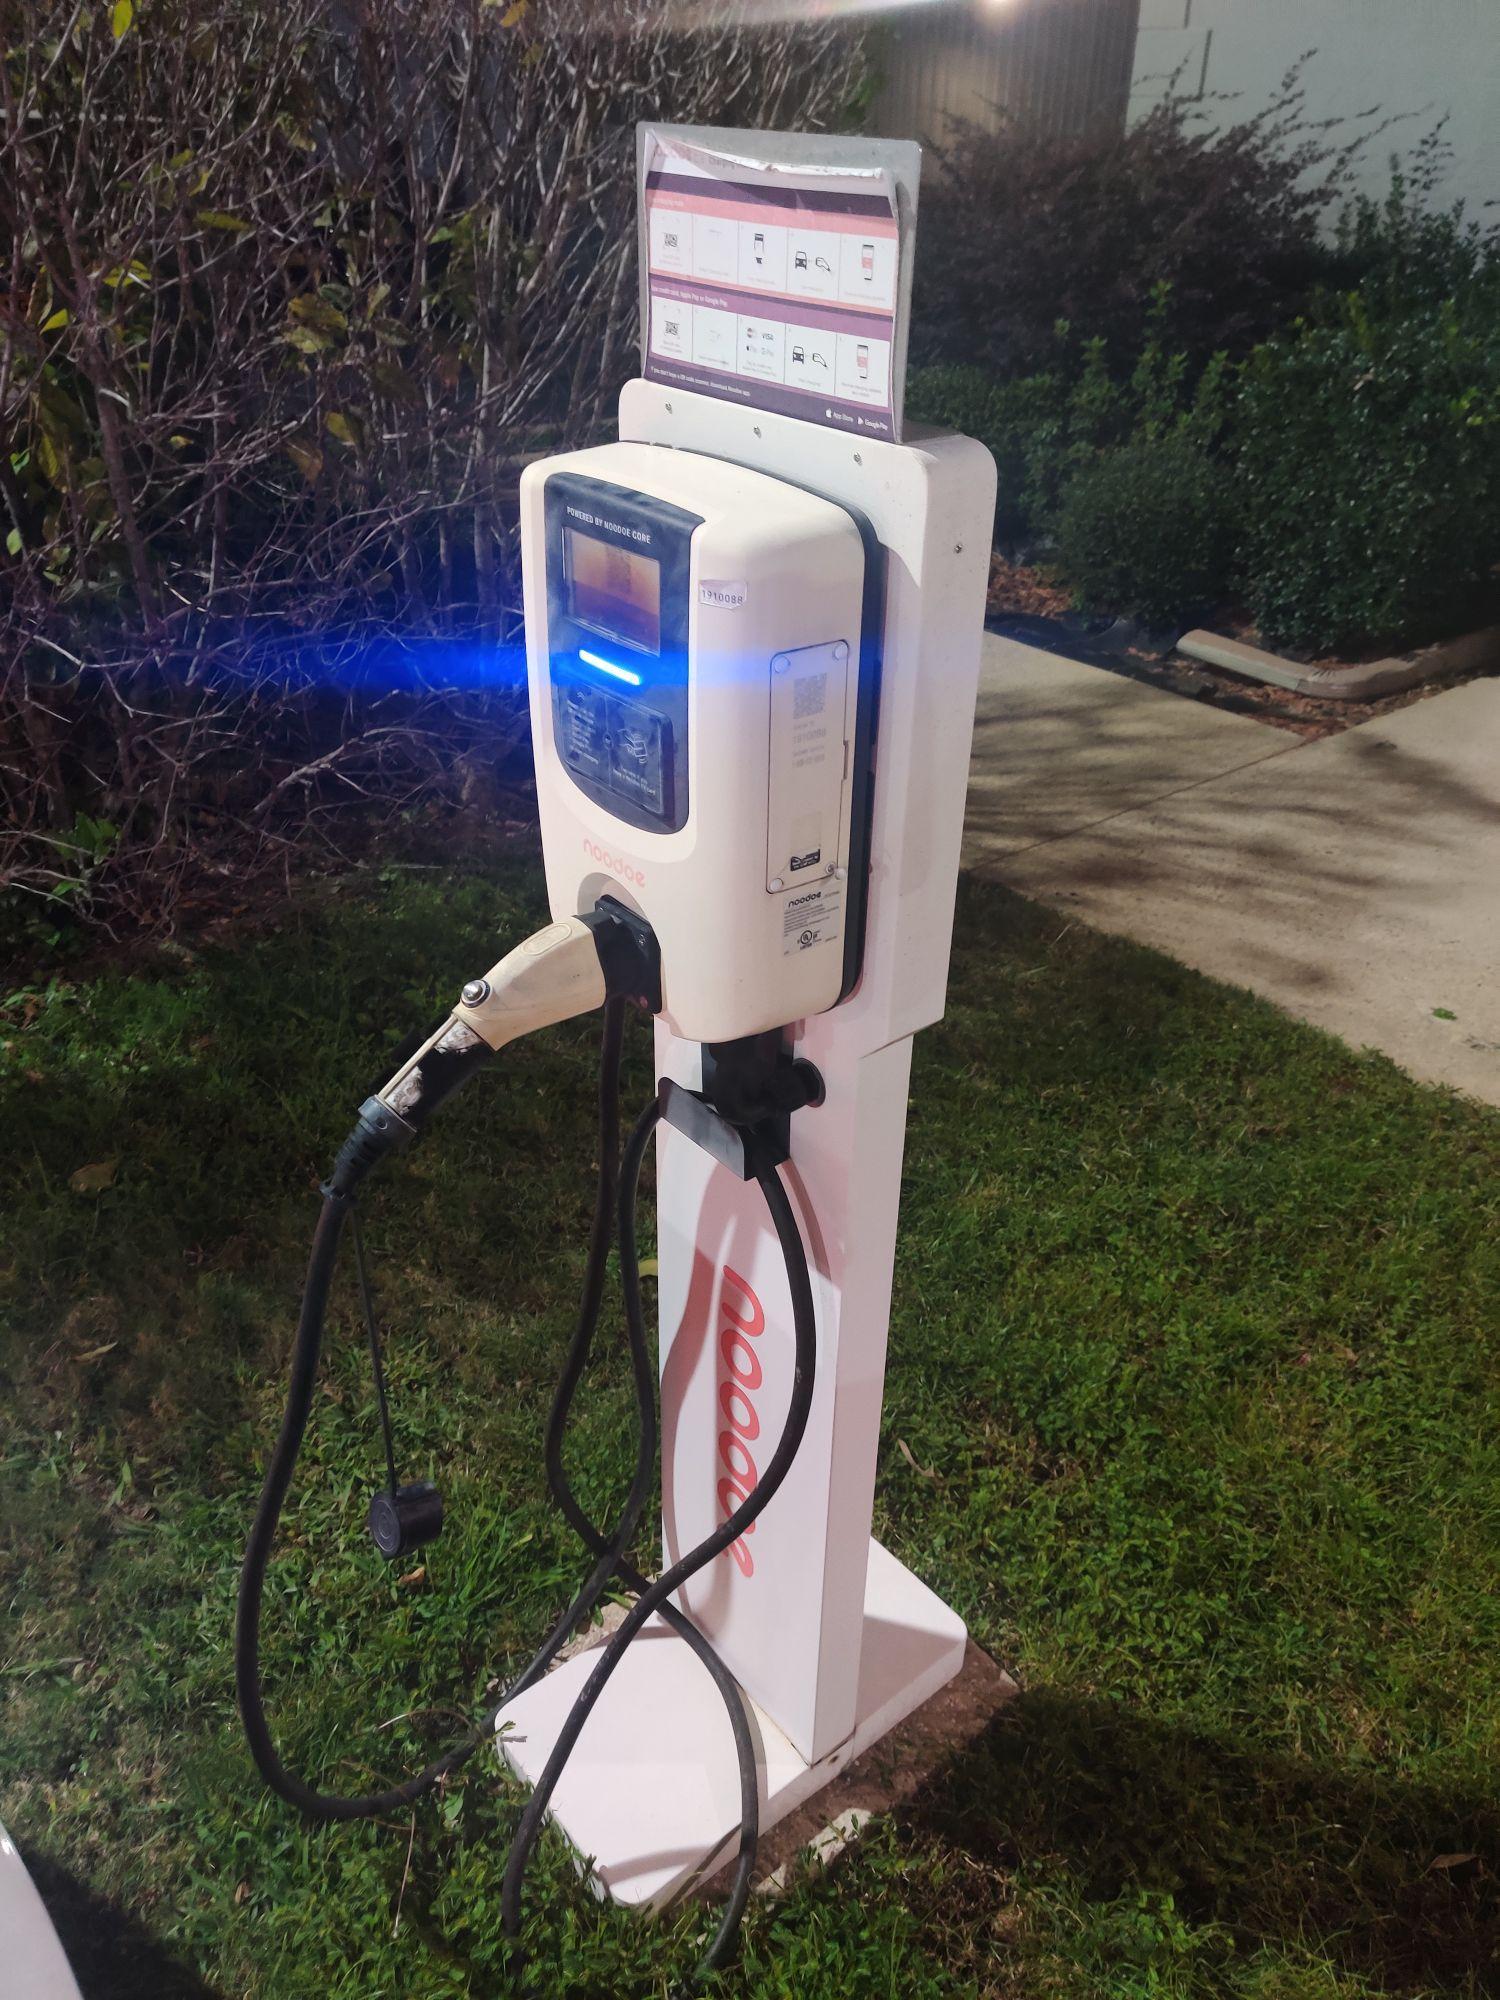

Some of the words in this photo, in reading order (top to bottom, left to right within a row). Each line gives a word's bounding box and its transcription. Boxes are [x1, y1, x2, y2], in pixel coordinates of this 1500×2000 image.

[865, 418, 880, 429] Google
[880, 421, 888, 430] Play
[566, 505, 594, 524] POWERED
[594, 516, 603, 527] BY
[604, 520, 631, 538] NOODOE
[632, 529, 651, 545] CORE
[702, 589, 743, 604] 1910088
[583, 838, 646, 888] noodoe
[788, 890, 822, 907] noodoe
